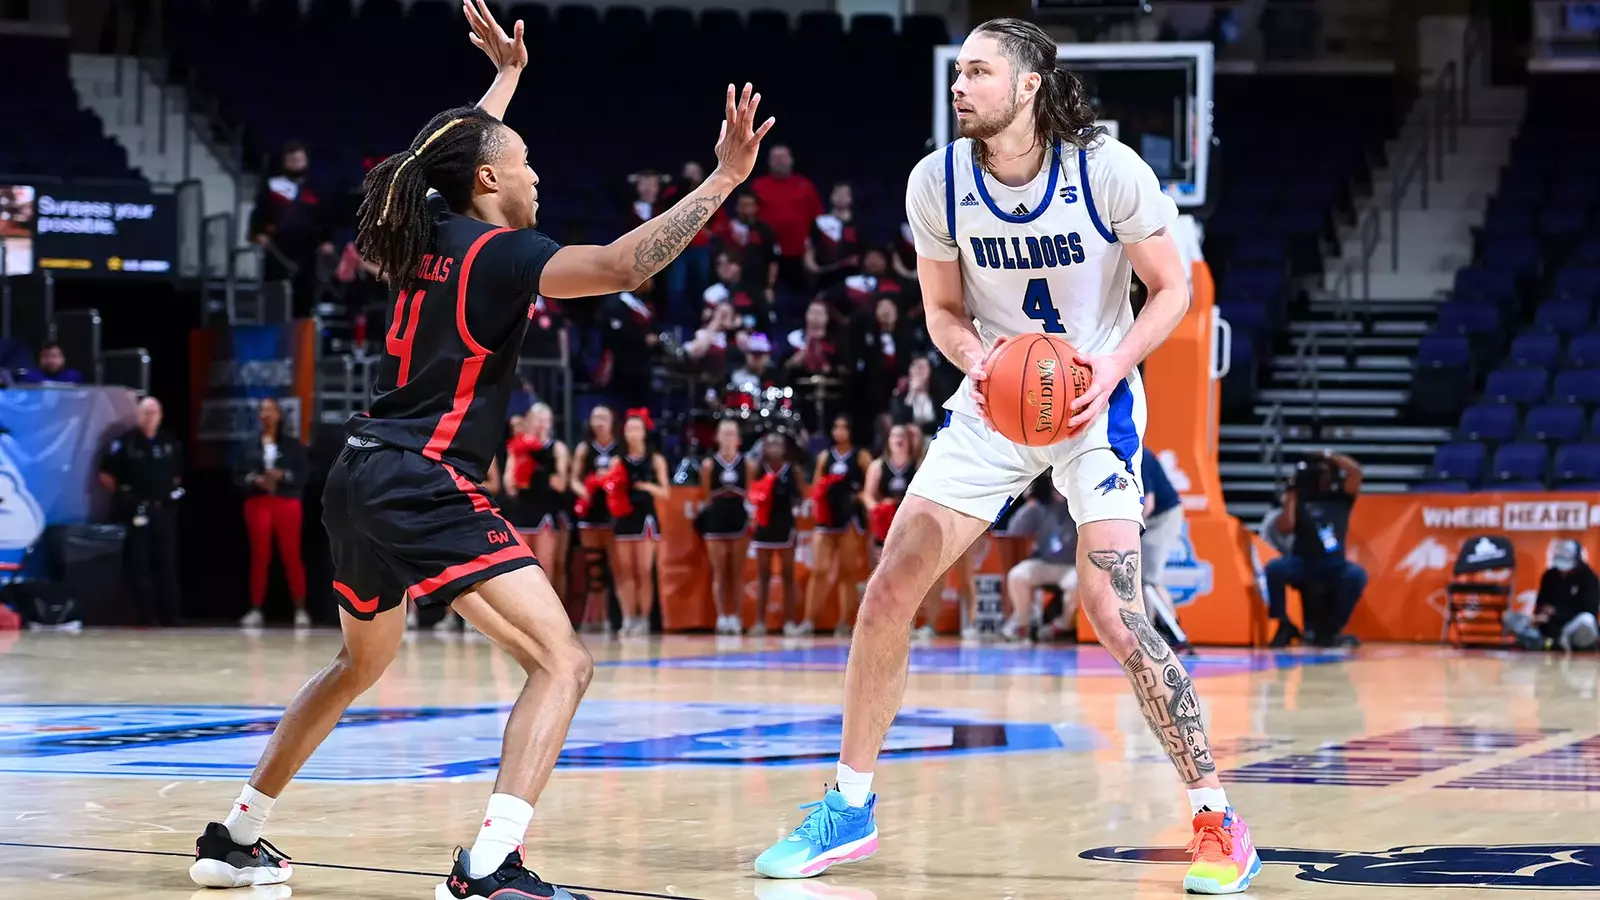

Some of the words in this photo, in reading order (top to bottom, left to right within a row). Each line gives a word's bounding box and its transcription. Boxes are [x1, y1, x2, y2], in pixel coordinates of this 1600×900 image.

[38, 195, 113, 217] Surpass
[115, 203, 154, 220] your
[969, 232, 1086, 270] BULLDOGS
[1021, 277, 1067, 334] 4
[386, 289, 427, 388] 4
[1035, 358, 1057, 433] SPALDING
[487, 529, 510, 545] GW
[1422, 505, 1500, 528] WHERE
[1508, 507, 1582, 524] HEART
[1133, 666, 1202, 784] PUSH
